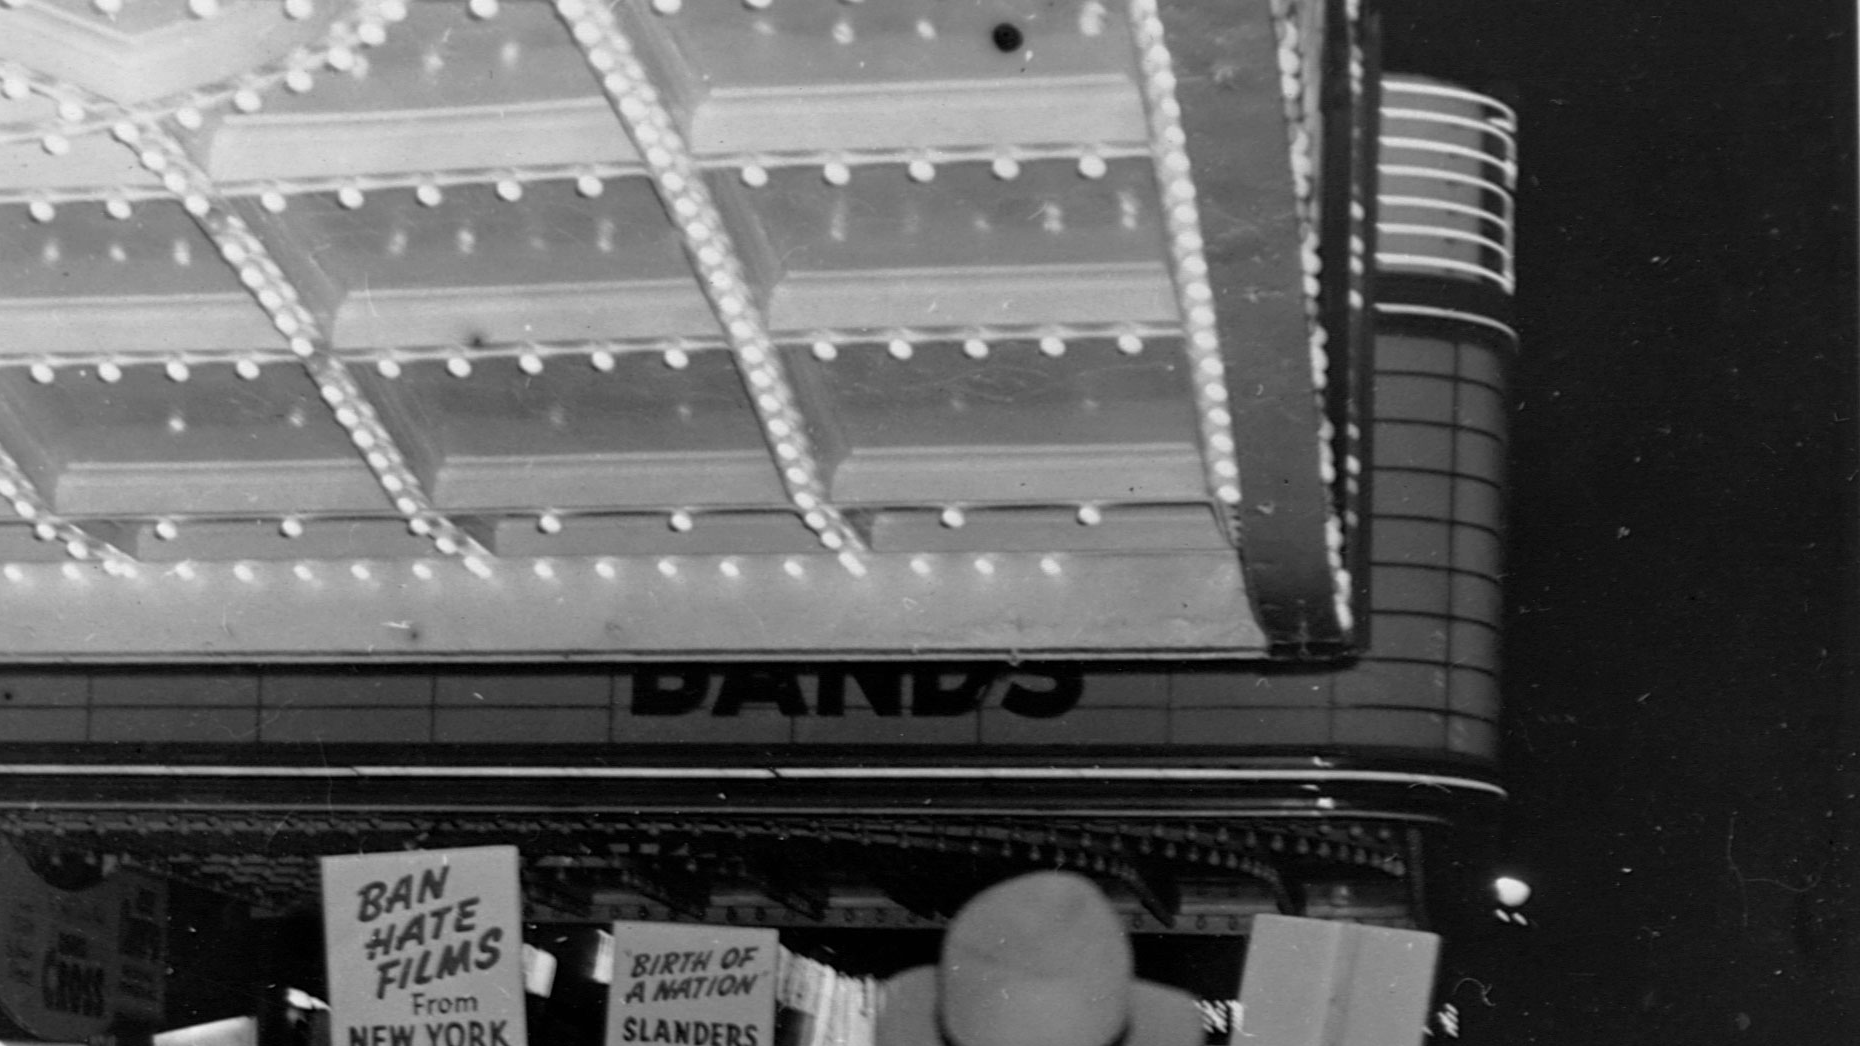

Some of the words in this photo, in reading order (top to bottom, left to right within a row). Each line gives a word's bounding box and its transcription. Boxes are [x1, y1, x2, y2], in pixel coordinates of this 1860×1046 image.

[357, 865, 450, 923] BAN
[364, 897, 480, 962] HATE
[376, 928, 503, 1000] FILMS
[720, 946, 760, 972] OF
[412, 993, 479, 1018] From
[625, 983, 647, 1006] A
